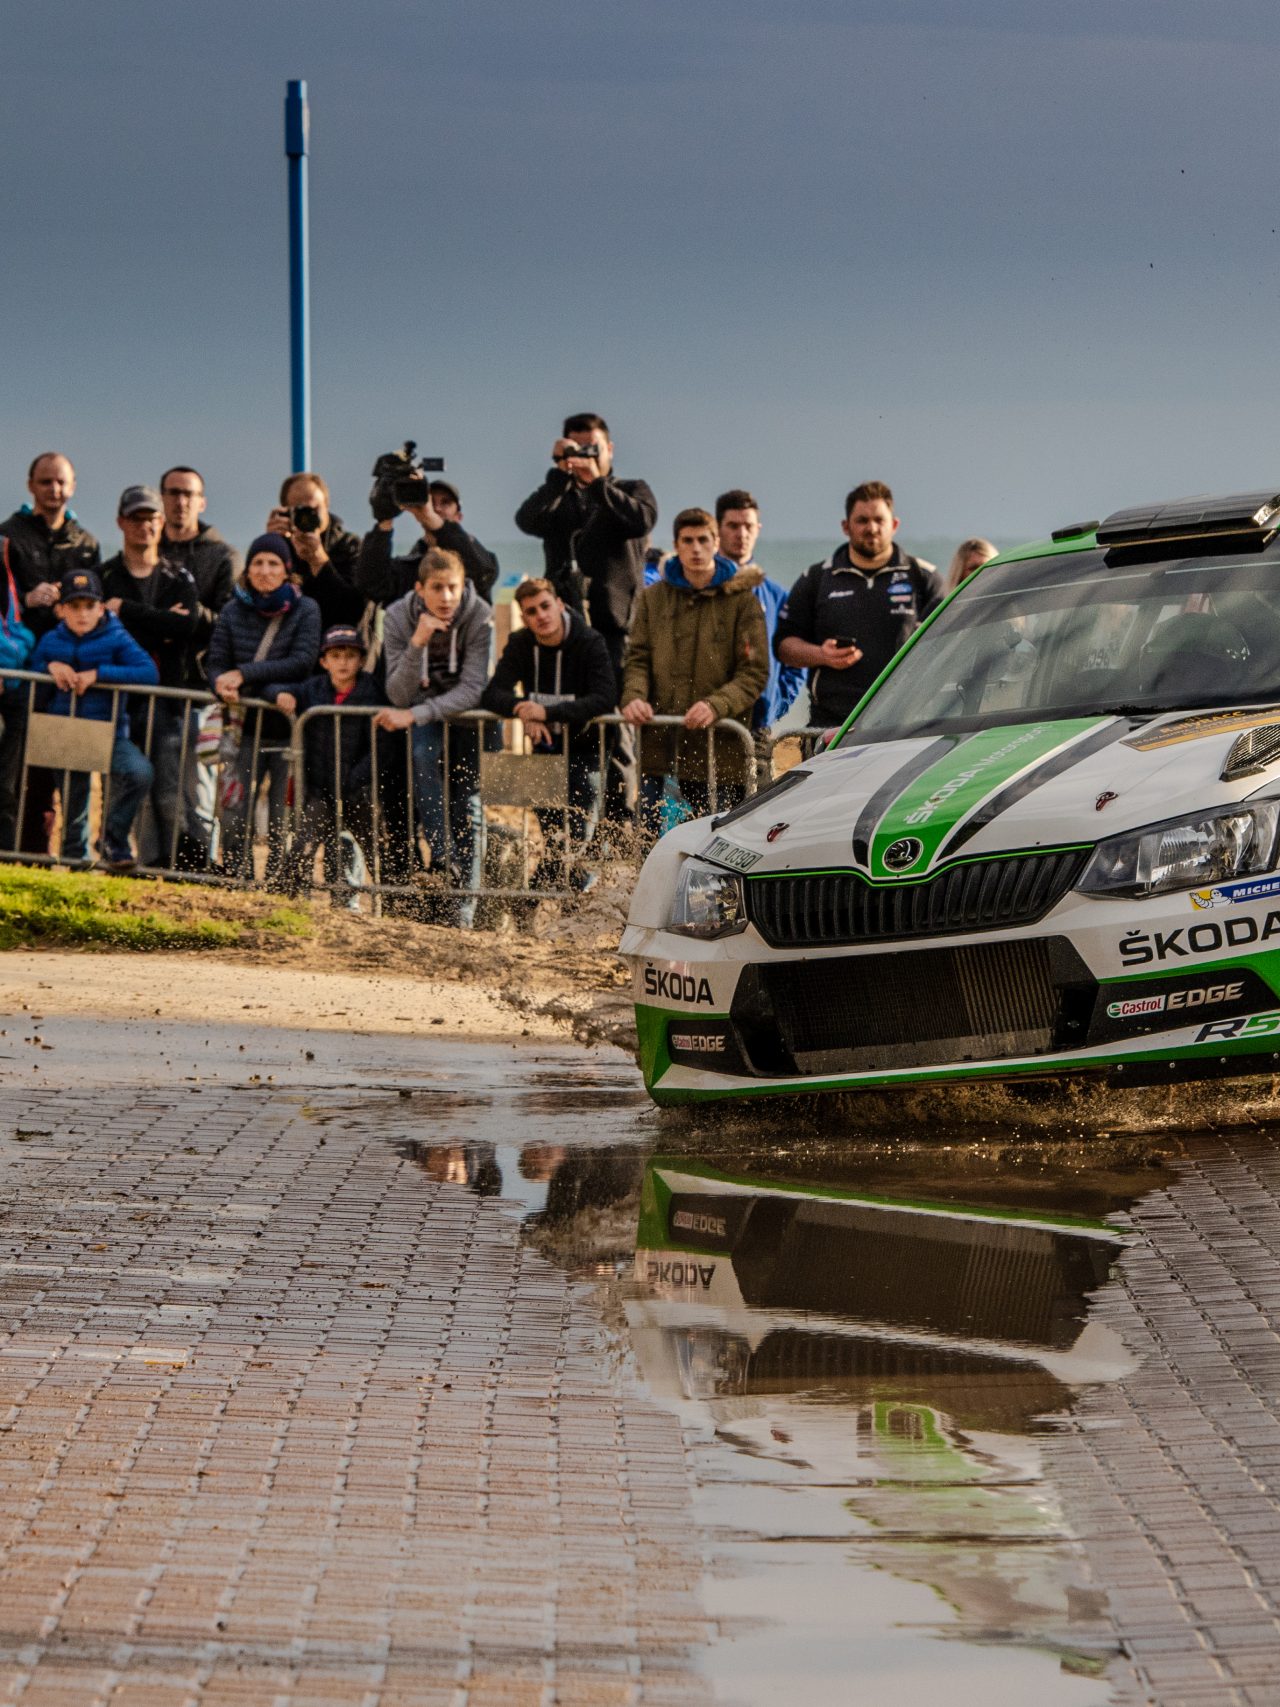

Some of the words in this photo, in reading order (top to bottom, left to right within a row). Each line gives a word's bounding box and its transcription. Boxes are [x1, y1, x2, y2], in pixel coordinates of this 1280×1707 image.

[724, 847, 756, 868] 0390
[644, 962, 715, 1006] ŠKODA
[1120, 998, 1162, 1016] Castrol
[1166, 981, 1246, 1011] EDGE
[692, 1035, 726, 1051] EDGE
